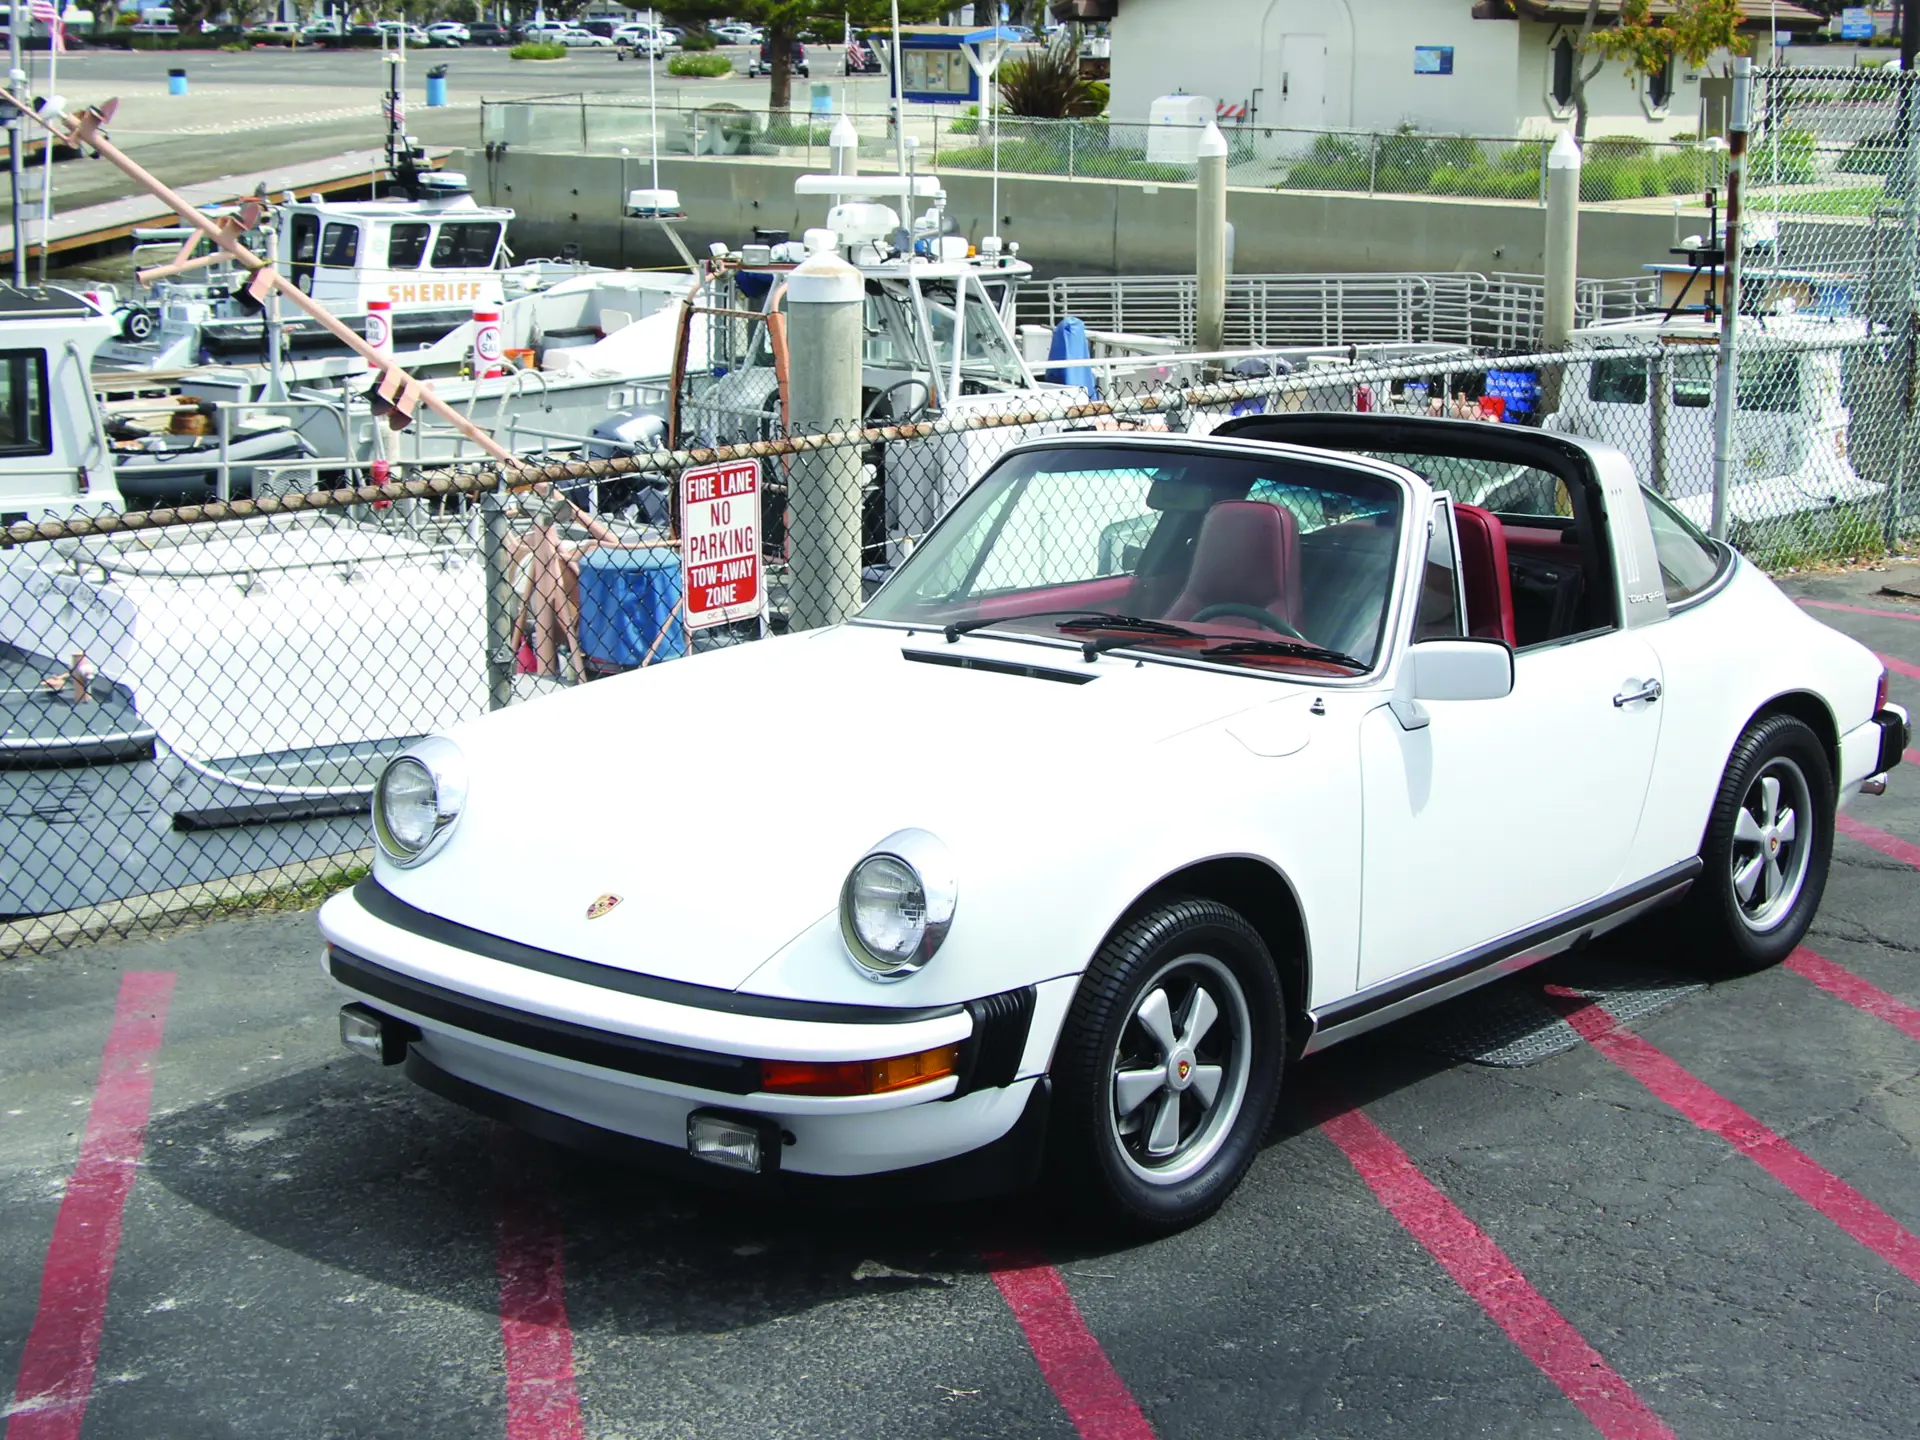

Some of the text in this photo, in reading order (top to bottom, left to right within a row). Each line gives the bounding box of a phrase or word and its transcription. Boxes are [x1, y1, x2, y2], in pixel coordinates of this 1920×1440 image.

[387, 283, 481, 303] SHERIFF
[367, 320, 379, 329] NO
[482, 343, 498, 352] SAI
[688, 470, 753, 501] FIRE LANE
[710, 500, 731, 527] NO
[690, 526, 753, 563] PARKING
[691, 558, 754, 588] TOW-AWAY
[706, 583, 737, 608] ZONE
[1628, 591, 1663, 604] targa
